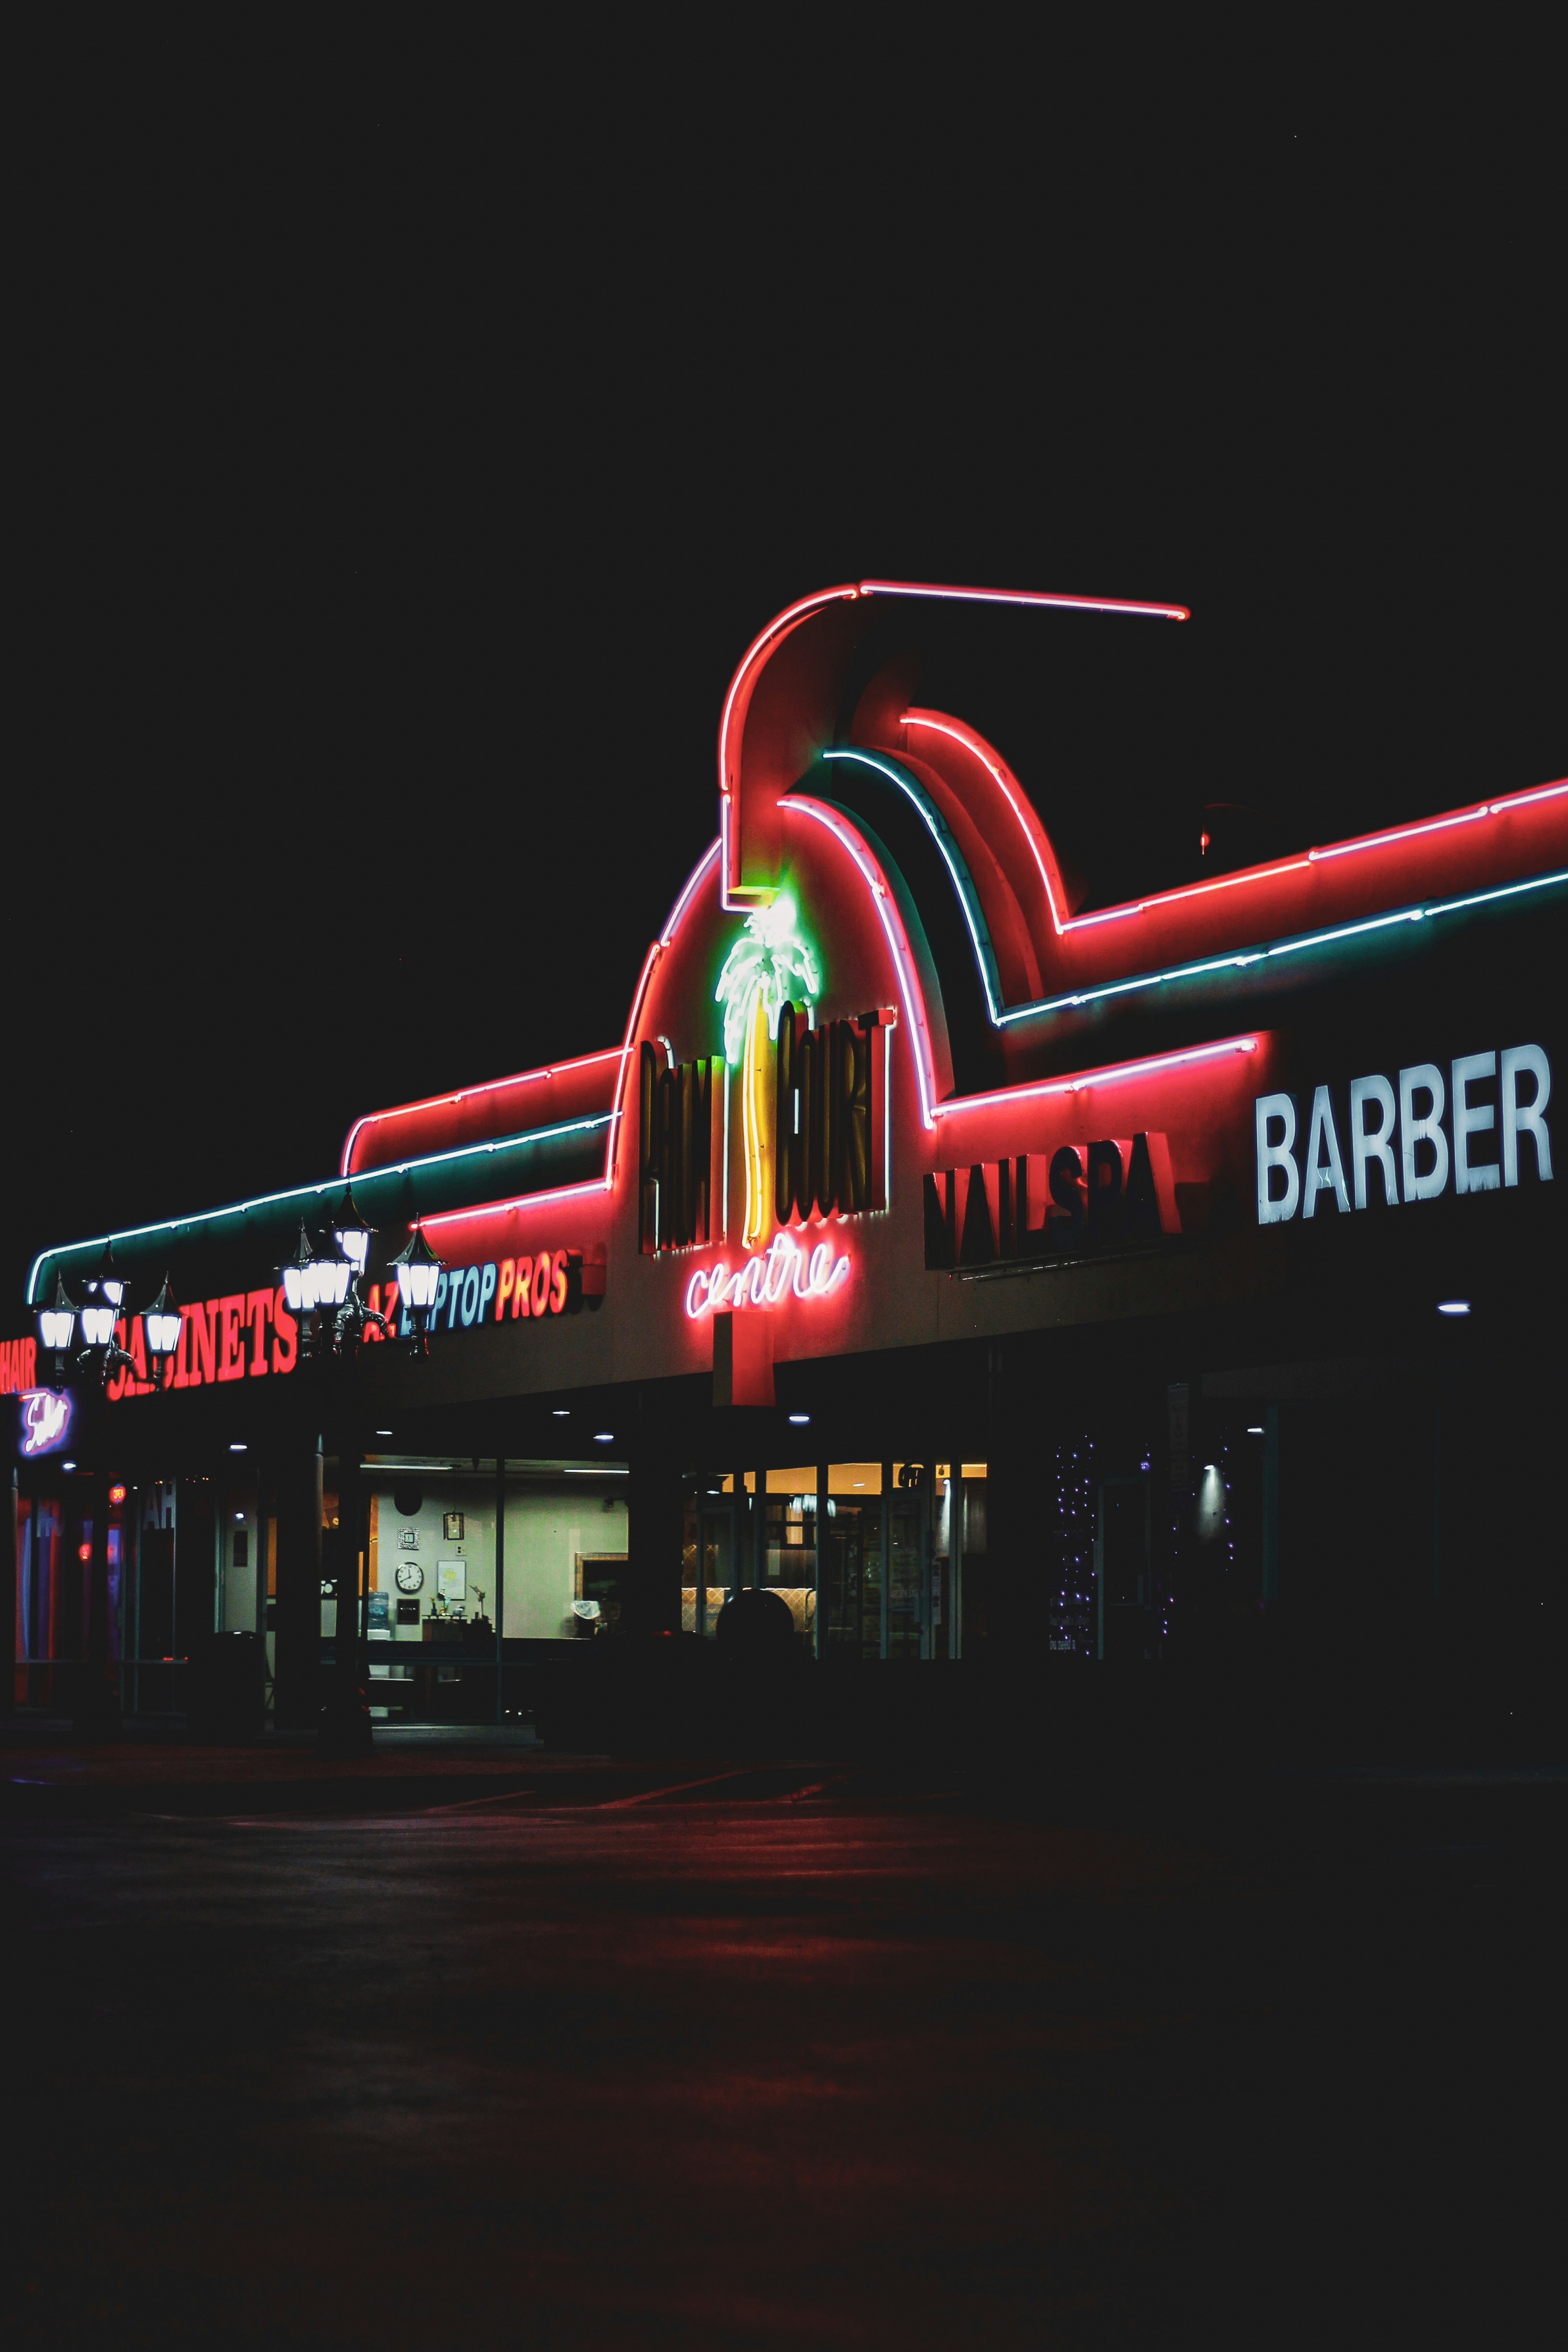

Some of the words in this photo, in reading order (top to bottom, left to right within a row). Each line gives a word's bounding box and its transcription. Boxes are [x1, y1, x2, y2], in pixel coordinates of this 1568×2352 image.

[638, 1038, 726, 1255] PALM
[775, 999, 896, 1228] COURT
[1254, 1042, 1554, 1225] BARBER
[922, 1153, 1047, 1271] NAIL
[1048, 1131, 1181, 1251] SPA
[494, 1249, 568, 1321] PROS
[686, 1230, 851, 1320] centre
[0, 1336, 37, 1395] HAIR
